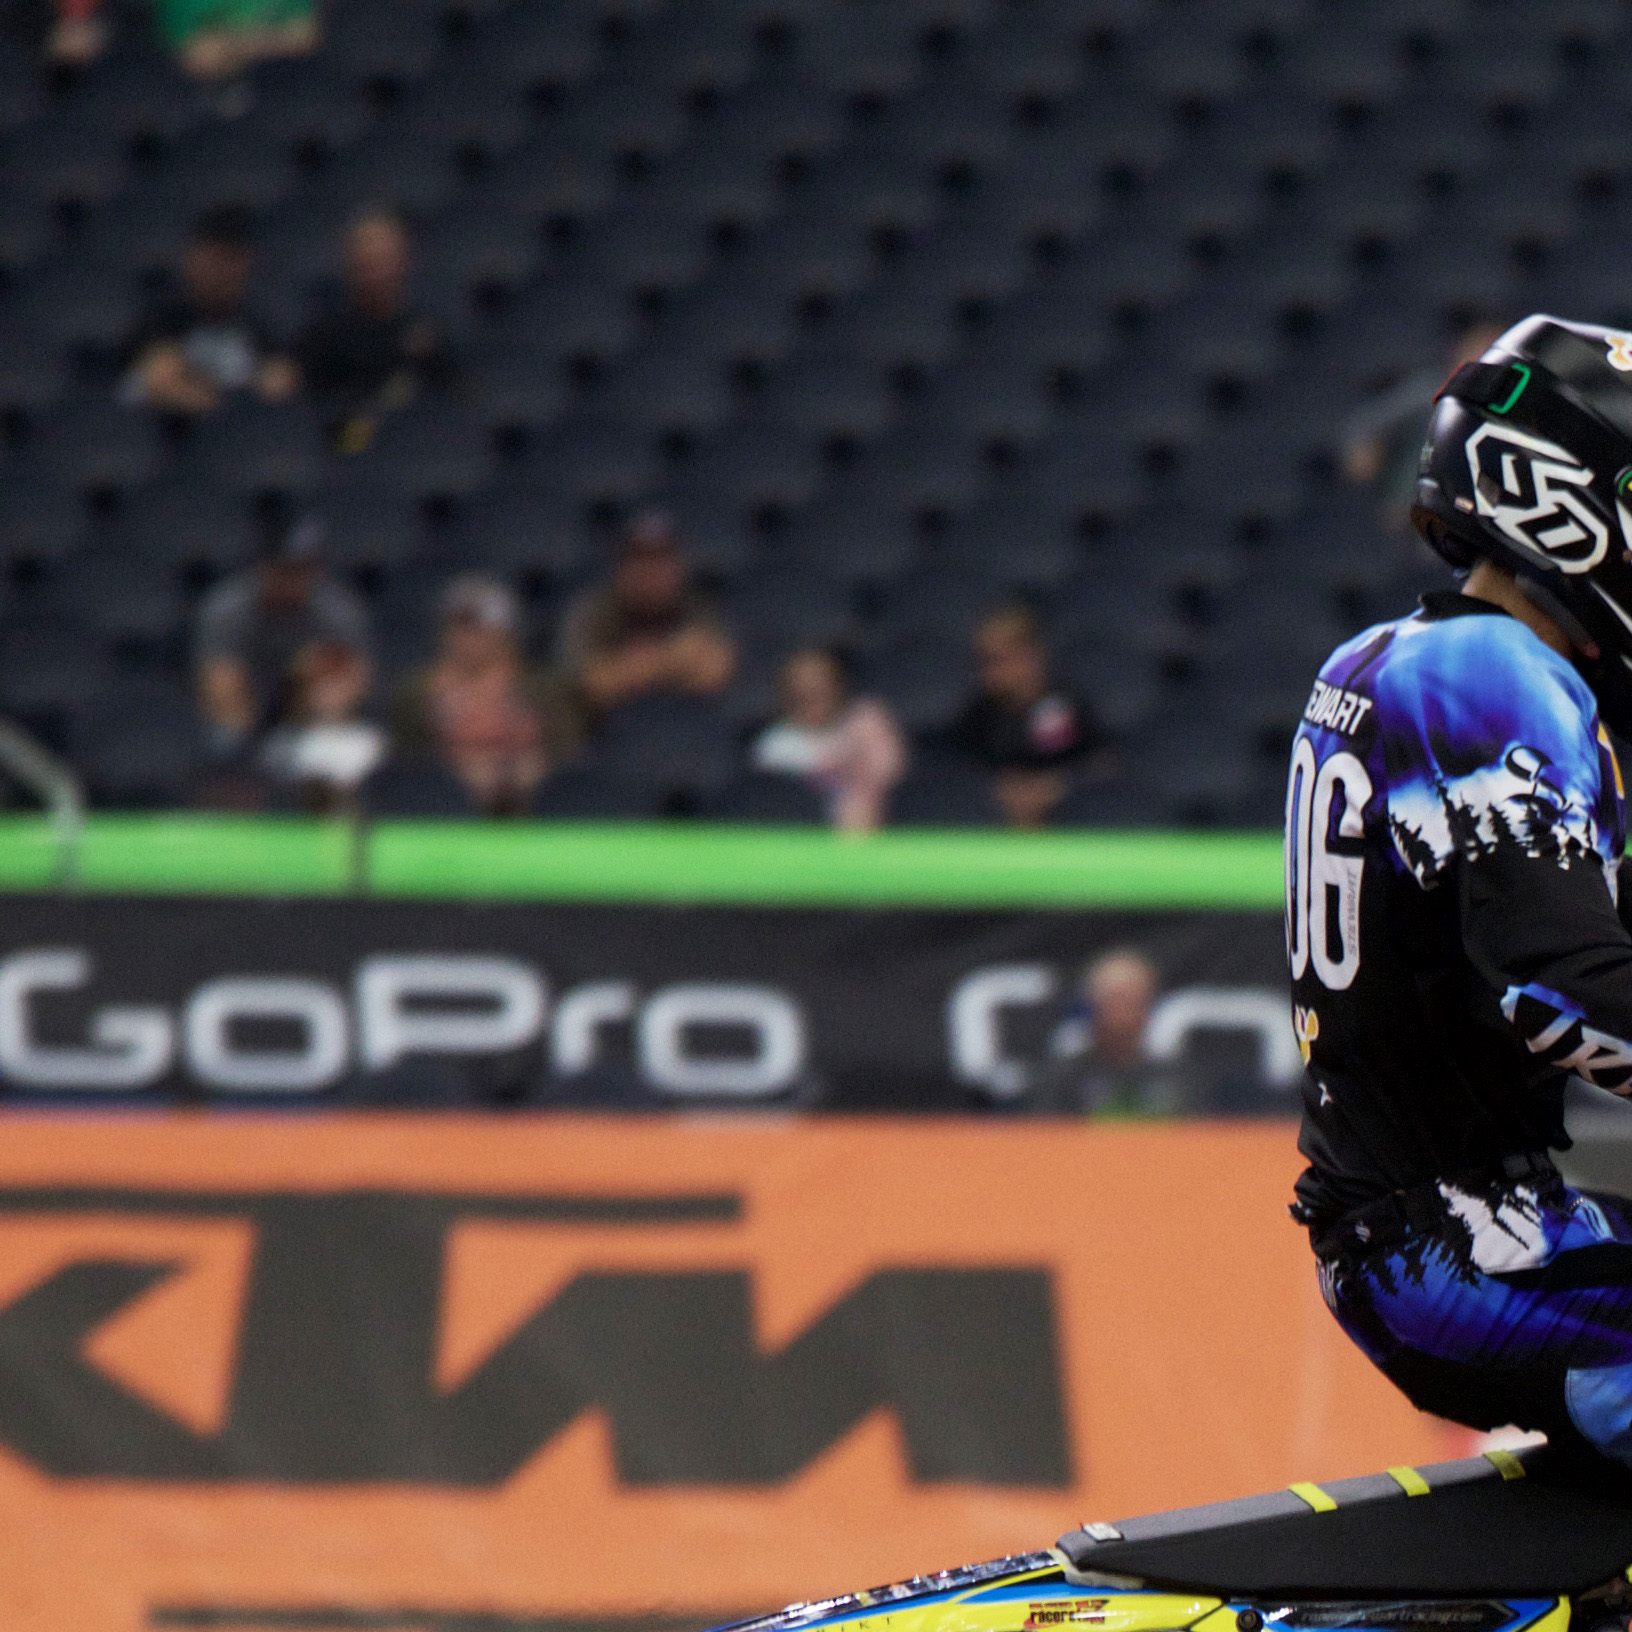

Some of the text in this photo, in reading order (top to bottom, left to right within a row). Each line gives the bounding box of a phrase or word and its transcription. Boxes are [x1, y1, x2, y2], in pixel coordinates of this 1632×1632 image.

[1303, 678, 1374, 736] EWART
[1284, 736, 1374, 991] 06
[0, 945, 805, 1095] GoPro
